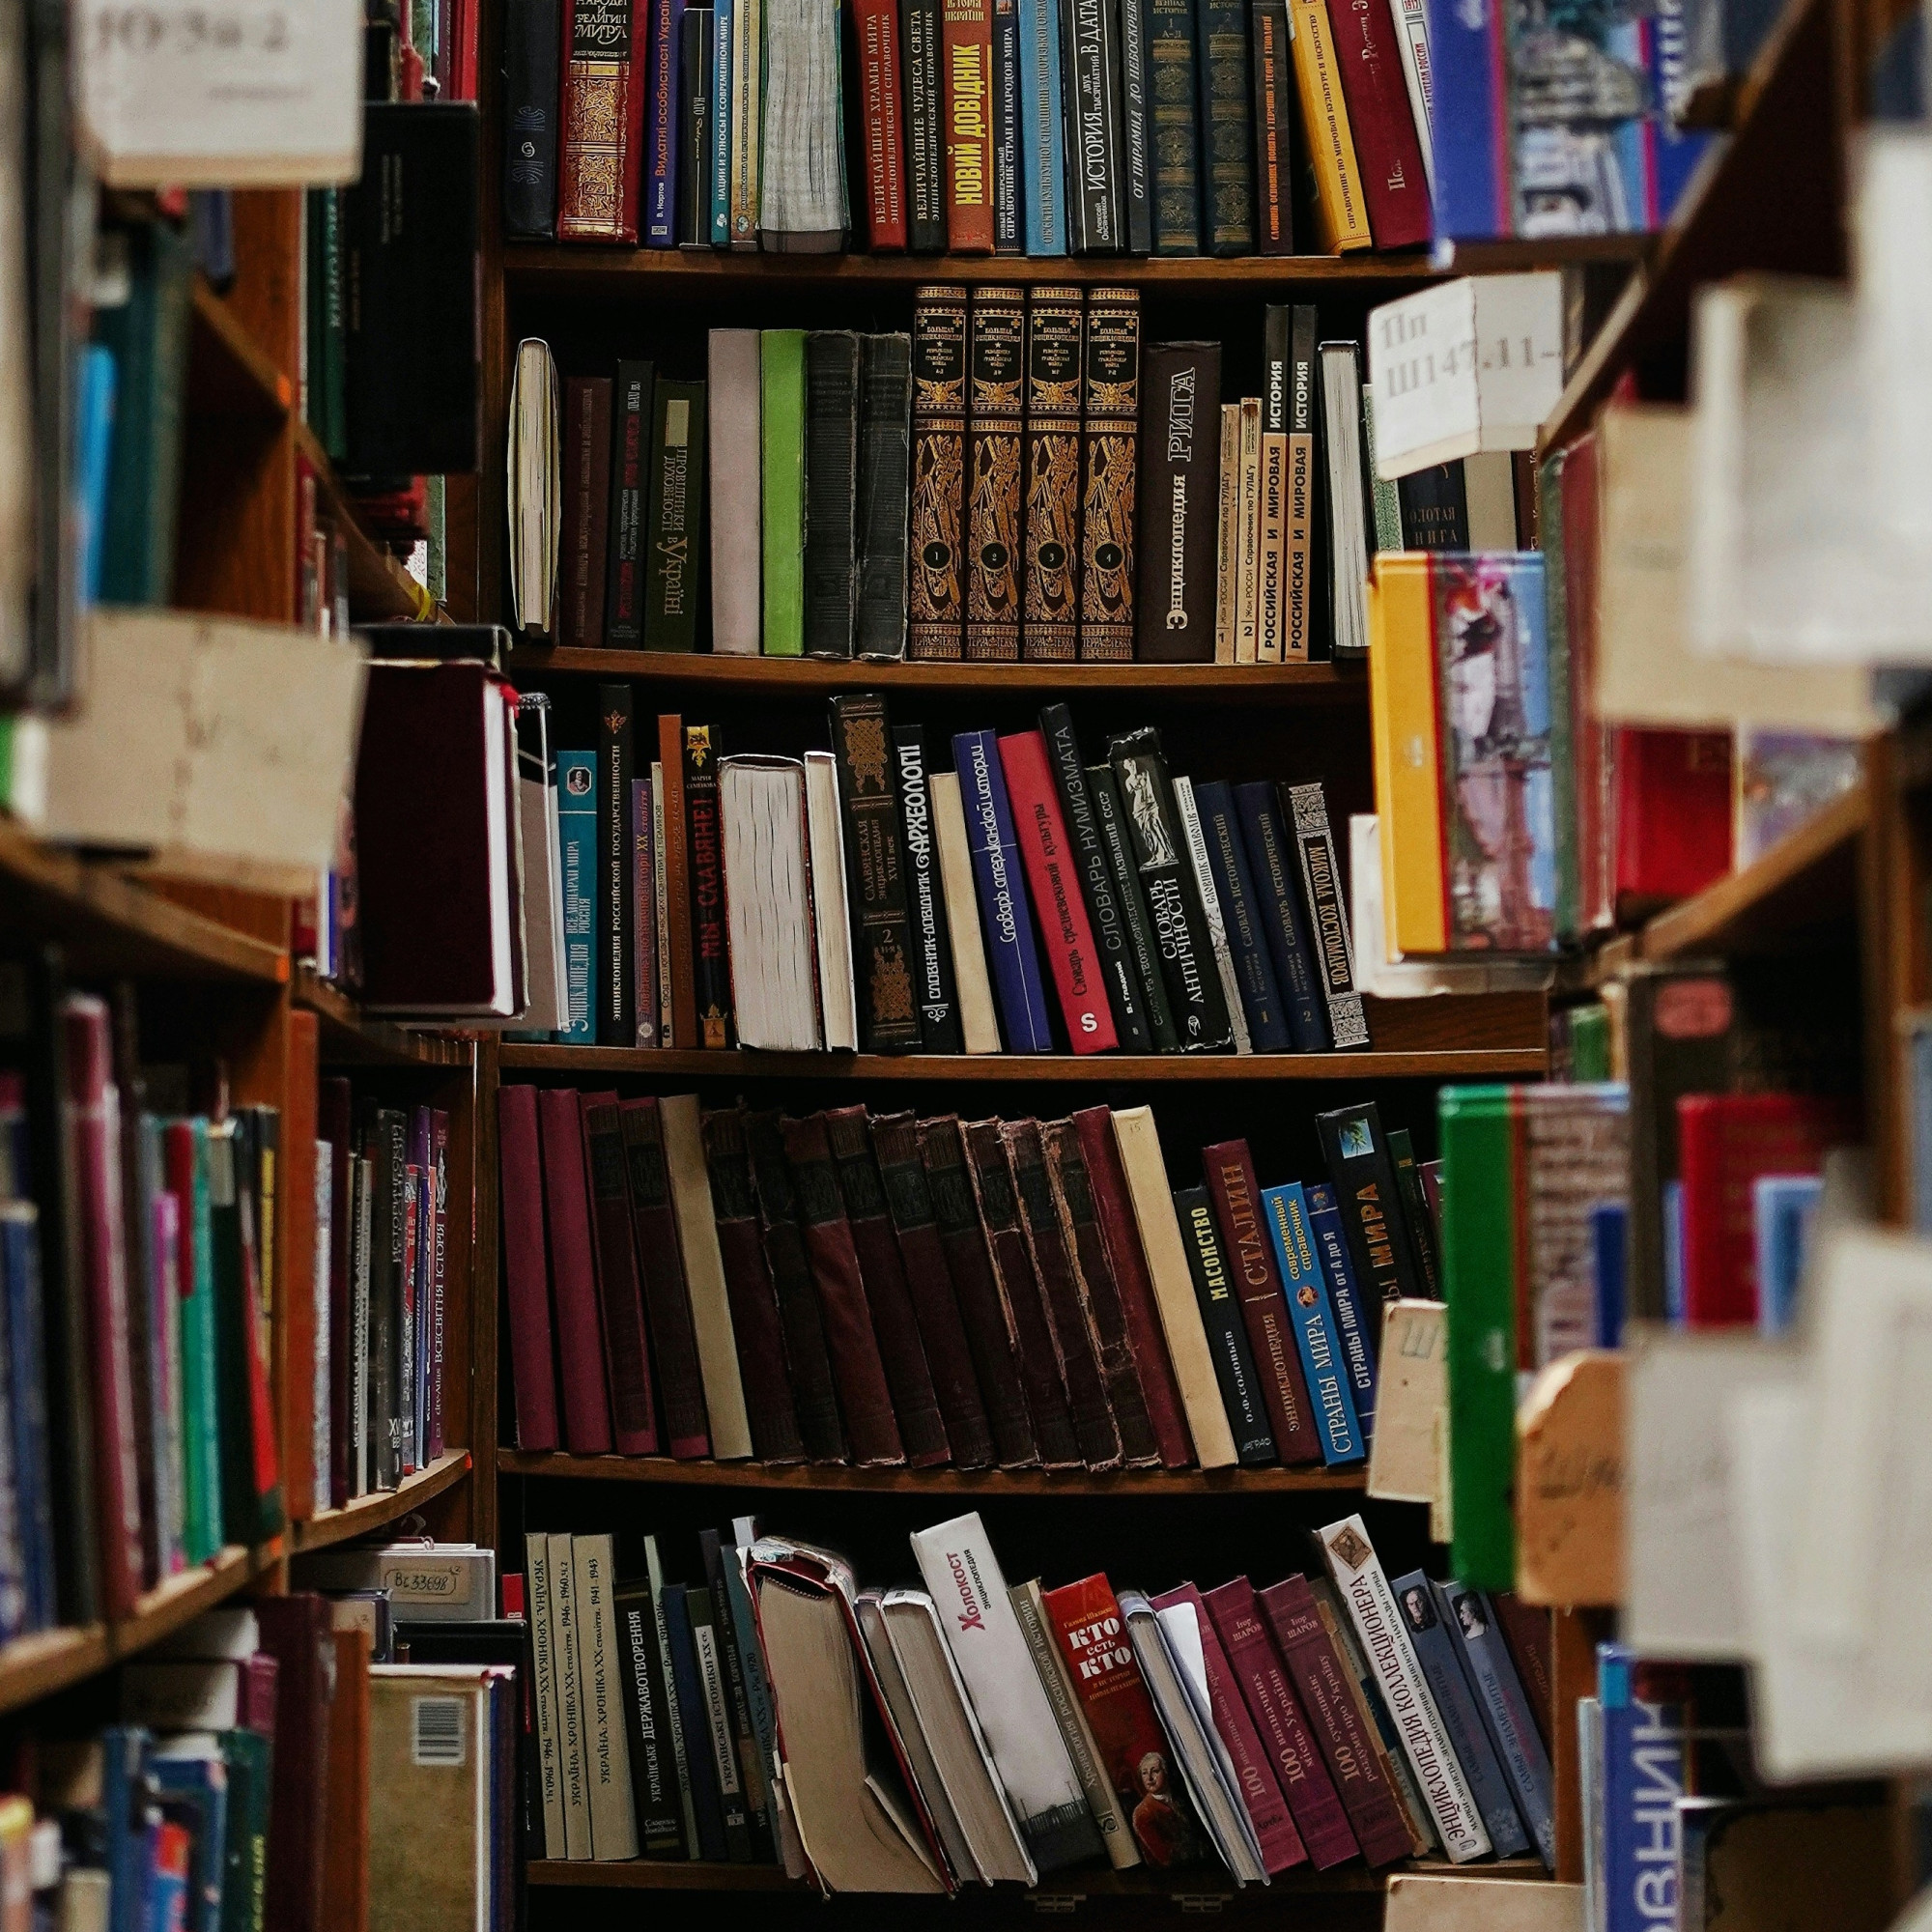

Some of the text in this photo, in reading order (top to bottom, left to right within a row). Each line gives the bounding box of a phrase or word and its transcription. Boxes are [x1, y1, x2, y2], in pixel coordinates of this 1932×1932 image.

[1080, 44, 1099, 54] В
[1082, 73, 1093, 95] ДВУХ
[655, 43, 669, 176] Видатні особистості
[693, 97, 706, 115] НАТО
[718, 15, 729, 201] НАЦИИ ЭТНОСЫ СОВРЕМЕННОМ МИРЕ
[866, 14, 887, 223] ВЕЛИЧАЙШИЕ ХРАМЫ МИРА
[881, 14, 899, 224] ЭНЦИКЛОПЕДИЧЕСКИЙ СПРАВОЧНИК
[910, 10, 927, 220] ВЕЛИЧАЙШИЕ ЧУДЕСА СВЕТА
[924, 11, 940, 221] ЭНЦИКЛОПЕДИЧЕСКИЙ СПРАВОЧНИК
[948, 43, 985, 205] НОВИЙ ДОВІДНИК
[1003, 26, 1015, 239] СПРАВОЧНИК СТРАН НАРОДОВ МИРА
[1084, 111, 1107, 190] ИСТОРИЯ
[1129, 83, 1145, 199] ОТ ПИРАМИД ДО
[1309, 14, 1356, 229] СПРАВОЧНИК ПО МИРОВОЙ КУЛЬТУРЕ ИСКУССТВУ
[662, 456, 675, 531] ДУХОВНОСТІ
[673, 450, 687, 530] ПРОВІДНИКИ
[1166, 366, 1197, 629] Энциклопедия РИГА
[1245, 465, 1256, 599] РОССИ Справочник ГУЛАГу
[1264, 360, 1283, 648] РОССИЙСКАЯ И МИРОВАЯ ИСТОРИЯ
[1289, 360, 1309, 649] РОССИЙСКАЯ И МИРОВАЯ ИСТОРИЯ
[657, 536, 688, 614] Україні
[1219, 471, 1232, 605] РОССИ Справочник ГУЛАГу
[1244, 626, 1254, 638] 2
[611, 745, 623, 1021] ЭНЦИКЛОПЕДИЯ РОССИЙСКОЙ ГОСУДАРСТВЕННОСТИ
[857, 820, 874, 901] СЛАВЯНСКАЯ
[871, 819, 888, 900] ЭНЦИКЛОПЕДИЯ
[885, 835, 896, 881] XVII век
[897, 745, 942, 1000] СЛОВНИК-ДОВІДНИК АРХЕОЛОГІЇ
[970, 745, 1018, 943] Словарь американской истории
[1054, 726, 1122, 950] СЛОВАРЬ НУМИЗМАТА
[1104, 821, 1126, 880] НАЗВАНИЙ
[1186, 812, 1215, 903] СЛОВНИК СИМВОЛІВ
[1213, 813, 1254, 948] СЛОВАРЬ ИСТОРИЧЕСКИЙ
[1256, 811, 1296, 947] СЛОВАРЬ ИСТОРИЧЕСКИЙ
[566, 840, 580, 934] ВСЕ МОНАРХИ МИРА
[579, 898, 591, 934] РОССИЯ
[1032, 803, 1089, 996] Словарь средневековой культуры
[1149, 879, 1177, 958] СЛОВАРЬ
[1307, 843, 1350, 985] МИКОЛА КОСТОМАРОВ
[881, 928, 893, 943] 2
[1114, 960, 1131, 1001] Гладкий
[1163, 877, 1204, 1003] АНТИЧНОСТИ
[1080, 1012, 1099, 1033] S
[1303, 1010, 1312, 1023] 2
[1189, 1206, 1229, 1300] МАСОНСТВО
[1220, 1164, 1267, 1286] СТАЛИН
[1270, 1195, 1301, 1280] современный
[1288, 1198, 1313, 1271] справочник
[1355, 1181, 1394, 1267] МИРА
[435, 1223, 445, 1363] ВСЕСВІТНЯ ІСТОРІЯ
[1321, 1230, 1372, 1389] СТРАНЫ МИРА А до Я
[1263, 1313, 1299, 1432] ЭНЦИКЛОПЕДИЯ
[1304, 1313, 1351, 1452] СТРАНЫ МИРА
[533, 1560, 549, 1673] УКРАЇНА: ХРОНІКА
[963, 1548, 991, 1610] ЭНЦИКЛОПЕДИЯ
[1067, 1617, 1121, 1651] КТО
[1078, 1646, 1131, 1680] КТО
[1086, 1639, 1116, 1656] есть
[1232, 1623, 1264, 1641] ШАРОВ
[1288, 1621, 1319, 1638] ШАРОВ
[1349, 1574, 1415, 1713] КОЛЛЕКЦИОНЕРА
[566, 1690, 578, 1746] ХРОНІКА
[594, 1669, 607, 1724] ХРОНІКА
[627, 1610, 661, 1802] УКРАЇНСЬКЕ ДЕРЖАВОТВОРЕННЯ
[703, 1660, 733, 1786] УКРАЇНСЬКІ ІСТОРИКИ
[1018, 1600, 1096, 1788] Хронология российской истории
[1268, 1668, 1313, 1767] місць України
[1319, 1655, 1343, 1704] Україну
[1339, 1704, 1355, 1728] про
[1371, 1569, 1477, 1831] МАРКИ МОНЕТЫ БАНКНОТЫ НАГРАДЫ ГЕРБЫ
[596, 1727, 611, 1783] УКРАЇНА:
[1253, 1673, 1306, 1784] 100 визначних
[1335, 1746, 1361, 1782] 100
[1350, 1731, 1378, 1781] роздуми
[568, 1749, 581, 1804] УКРАЇНА:
[1242, 1766, 1266, 1797] 100
[1401, 1712, 1464, 1841] ЭНЦИКЛОПЕДИЯ
